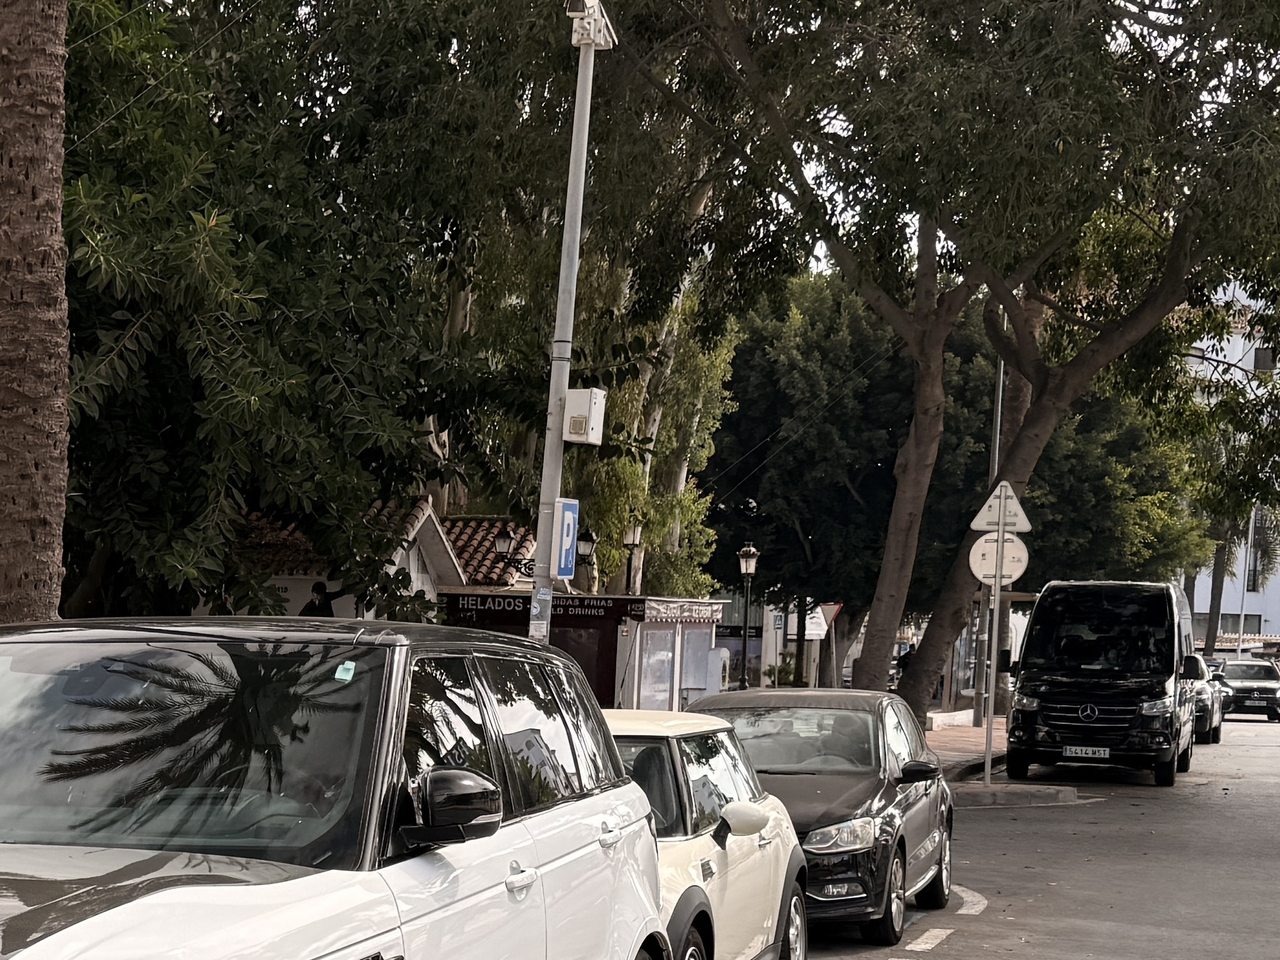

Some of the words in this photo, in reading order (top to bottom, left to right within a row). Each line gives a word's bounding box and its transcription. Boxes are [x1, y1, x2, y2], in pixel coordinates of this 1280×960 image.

[561, 511, 574, 568] P
[459, 596, 523, 610] HELADOS
[584, 599, 613, 607] FRIAS
[568, 607, 605, 616] DRINKS
